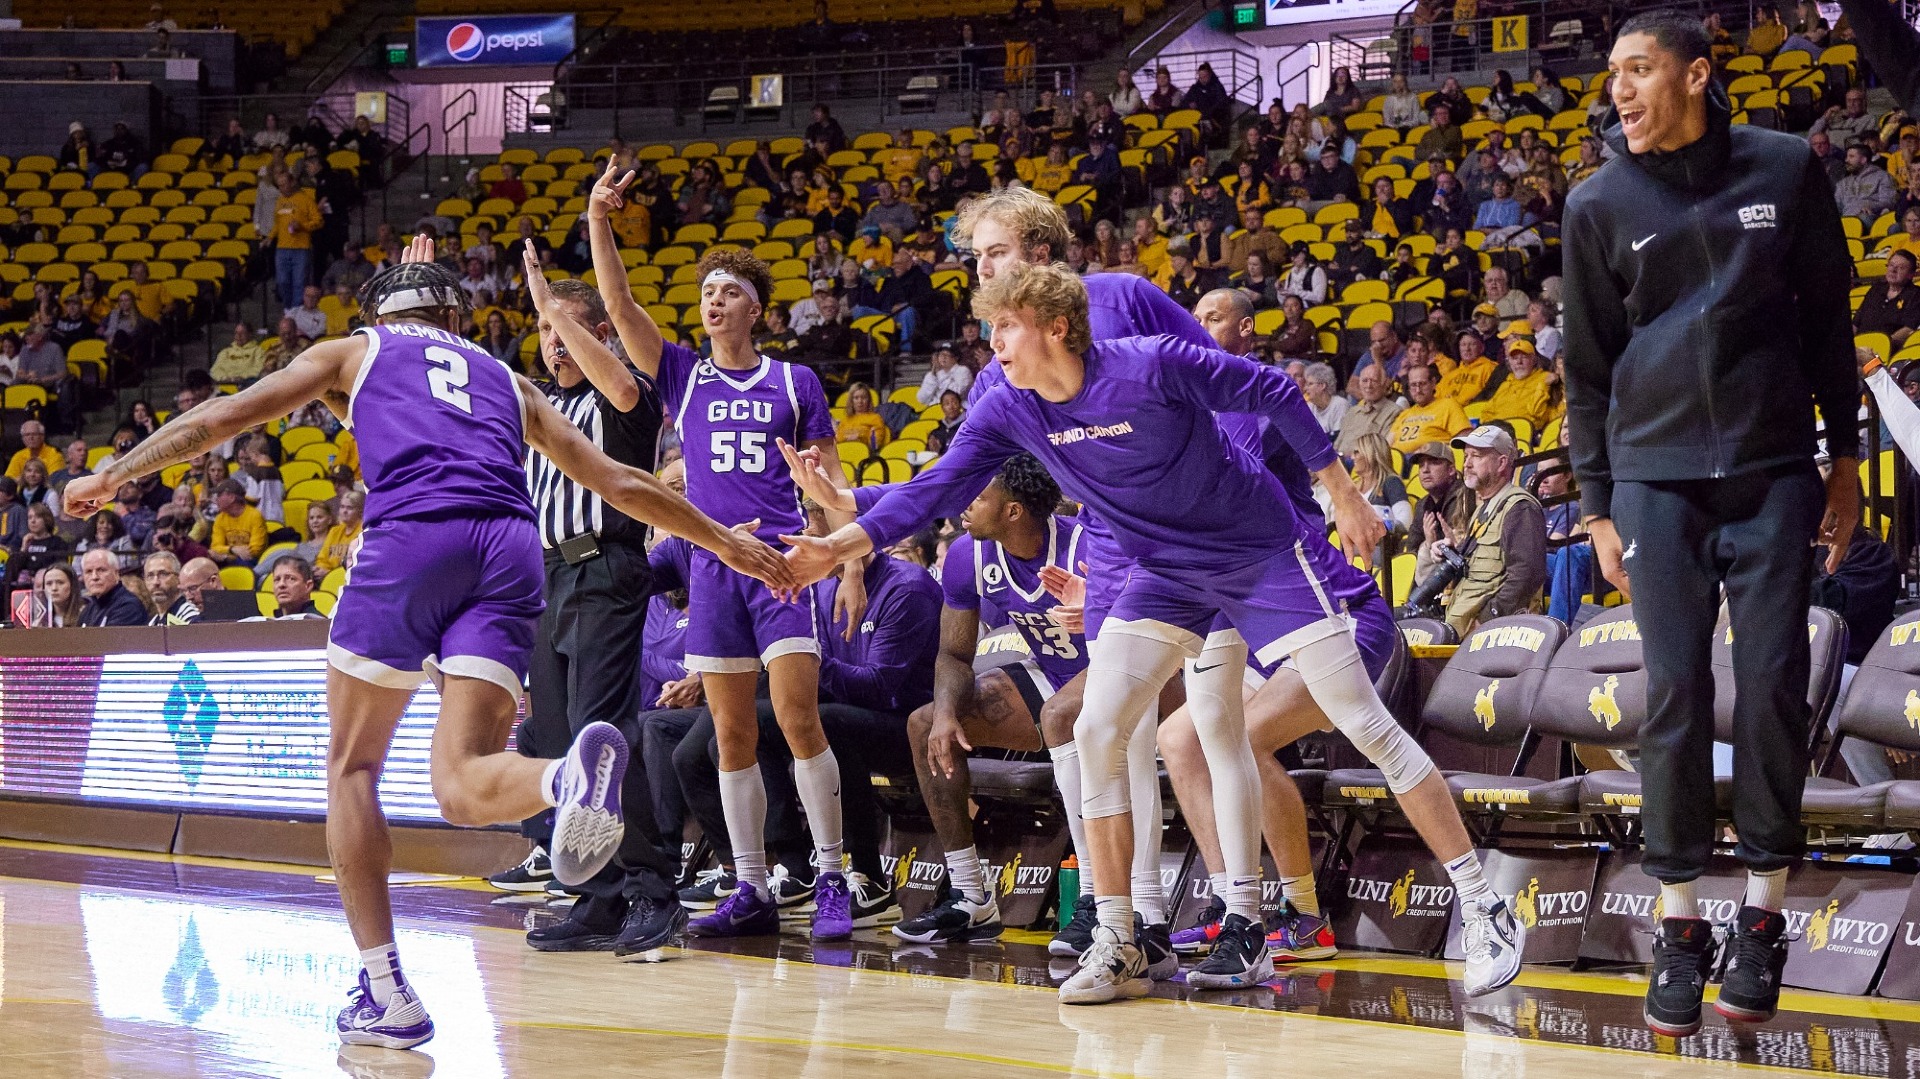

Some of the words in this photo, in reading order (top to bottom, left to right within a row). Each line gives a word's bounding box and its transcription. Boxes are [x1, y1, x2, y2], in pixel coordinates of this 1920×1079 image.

[1237, 9, 1254, 24] EXIT
[486, 31, 543, 52] pepsi
[1501, 20, 1519, 47] K
[759, 77, 779, 103] K
[1737, 204, 1776, 223] GCU
[424, 345, 473, 415] 2
[707, 399, 773, 423] GCU
[1399, 425, 1420, 442] 22
[710, 431, 767, 473] 55
[989, 567, 997, 582] 4
[675, 617, 690, 629] GC
[860, 621, 875, 634] GCU
[1028, 626, 1080, 660] 13
[1469, 626, 1545, 653] WYOMING
[1463, 787, 1531, 804] WYOMING
[911, 860, 945, 882] WYO
[1016, 866, 1052, 885] WYO
[906, 881, 922, 890] CREDIT
[1347, 877, 1392, 902] UNI
[1408, 884, 1454, 906] WYO
[1406, 908, 1428, 917] CREDIT
[1427, 909, 1447, 918] UNION
[1537, 890, 1587, 916] WYO
[1601, 892, 1655, 917] UNI
[1697, 898, 1737, 922] YO
[1537, 918, 1561, 927] CREDIT
[1561, 916, 1583, 926] UNION
[1832, 917, 1889, 945] WYO
[1826, 943, 1854, 954] CREDIT
[1854, 946, 1879, 958] UNION
